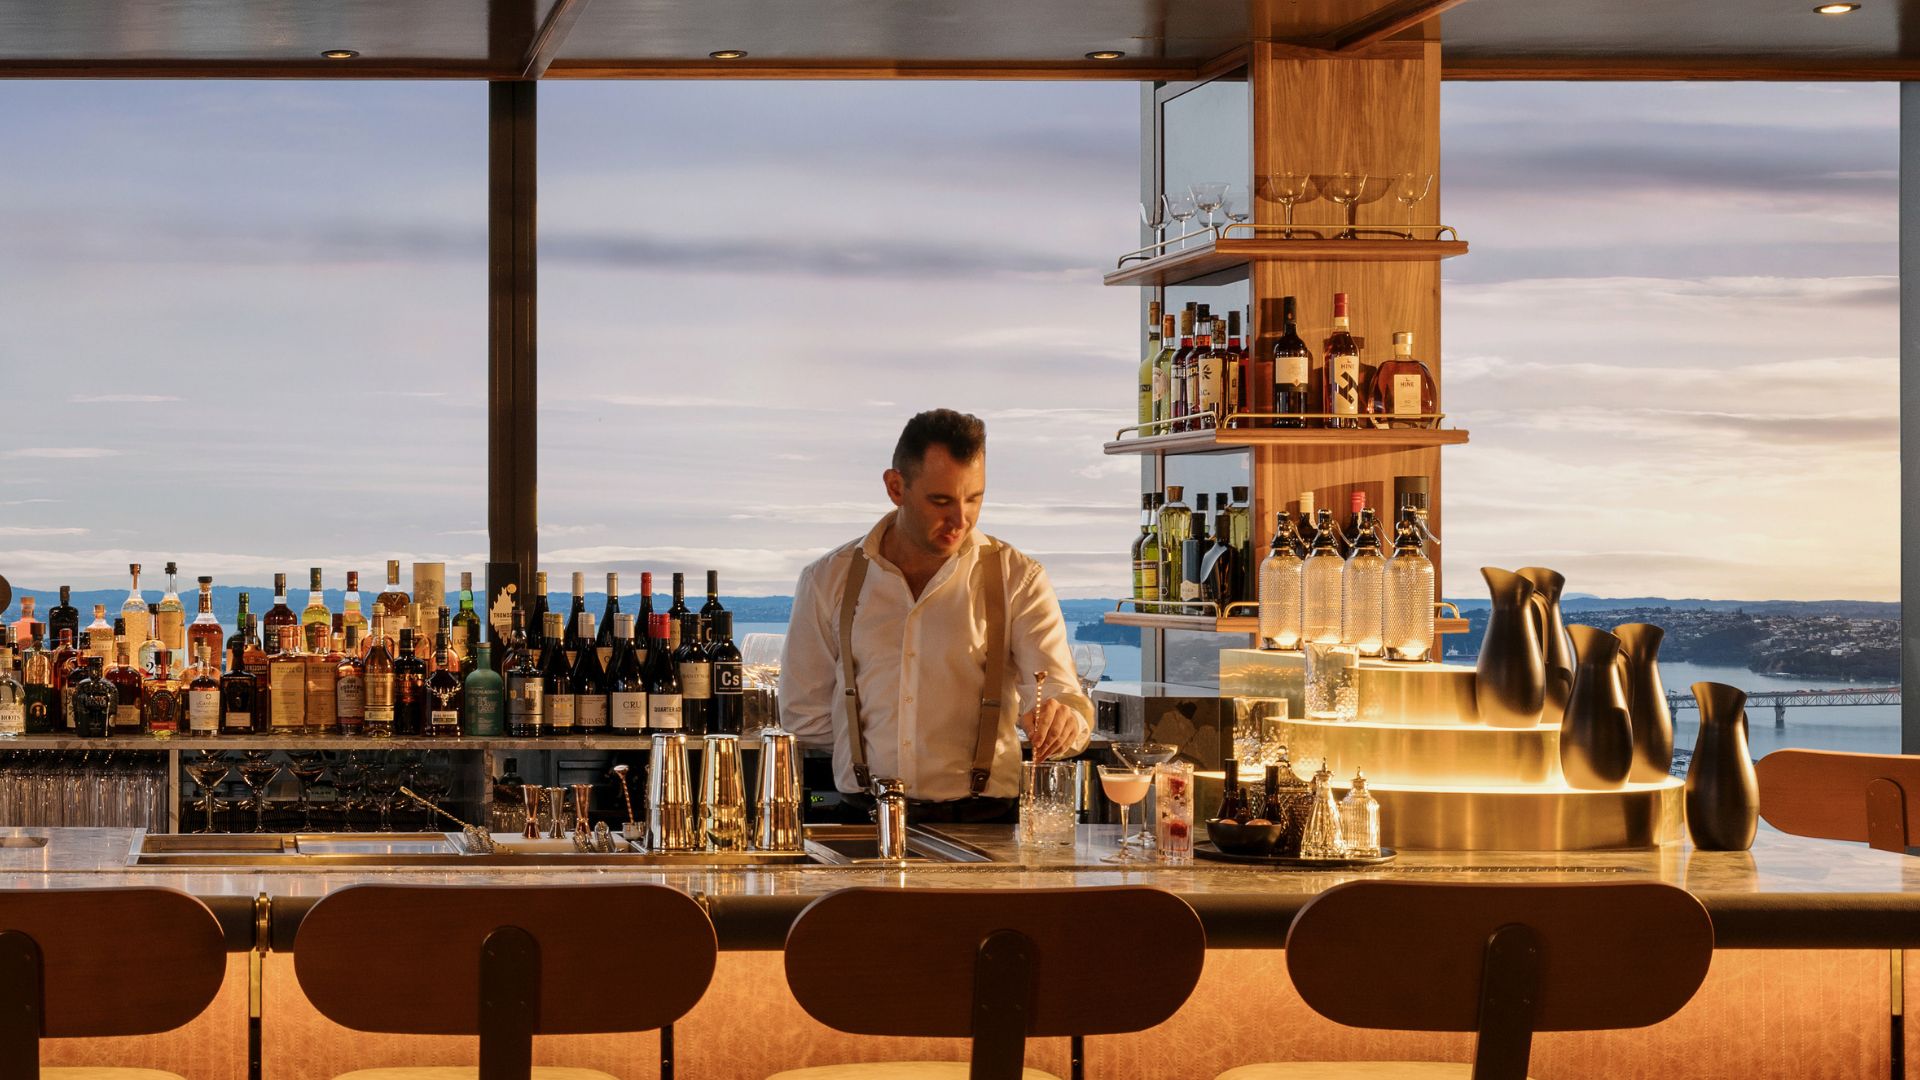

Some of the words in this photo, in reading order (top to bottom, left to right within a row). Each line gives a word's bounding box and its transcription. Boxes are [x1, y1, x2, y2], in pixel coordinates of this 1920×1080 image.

[721, 671, 740, 686] Cs
[623, 701, 641, 709] CRU
[578, 717, 606, 725] CRIMSO
